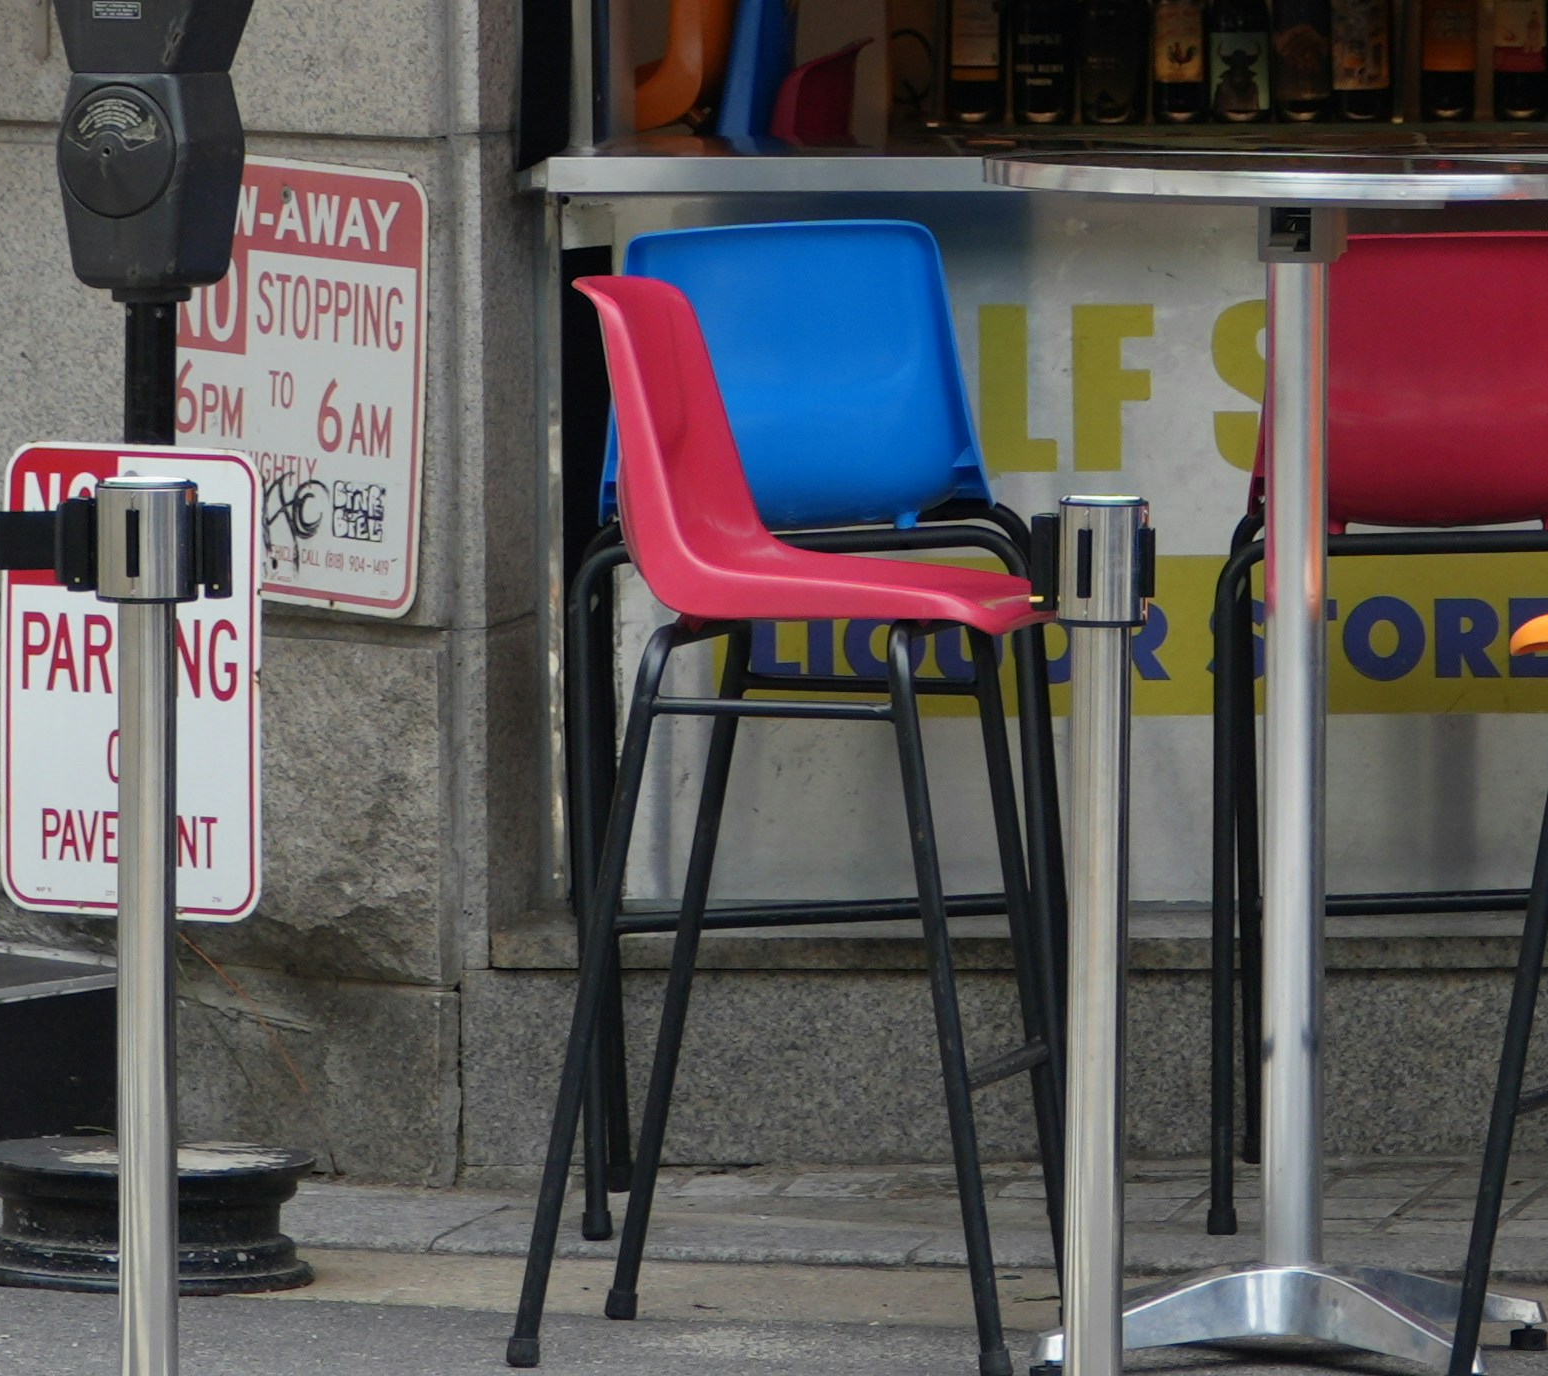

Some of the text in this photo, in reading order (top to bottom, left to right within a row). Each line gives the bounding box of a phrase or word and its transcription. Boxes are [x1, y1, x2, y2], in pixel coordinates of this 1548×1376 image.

[234, 184, 401, 252] W-AWAY
[257, 271, 403, 352] STOPPING
[269, 369, 294, 409] TO
[978, 303, 1154, 473] LF
[302, 548, 320, 567] CALL
[326, 551, 344, 571] (818)
[22, 611, 239, 702] PARNG
[42, 809, 219, 869] PAVENT
